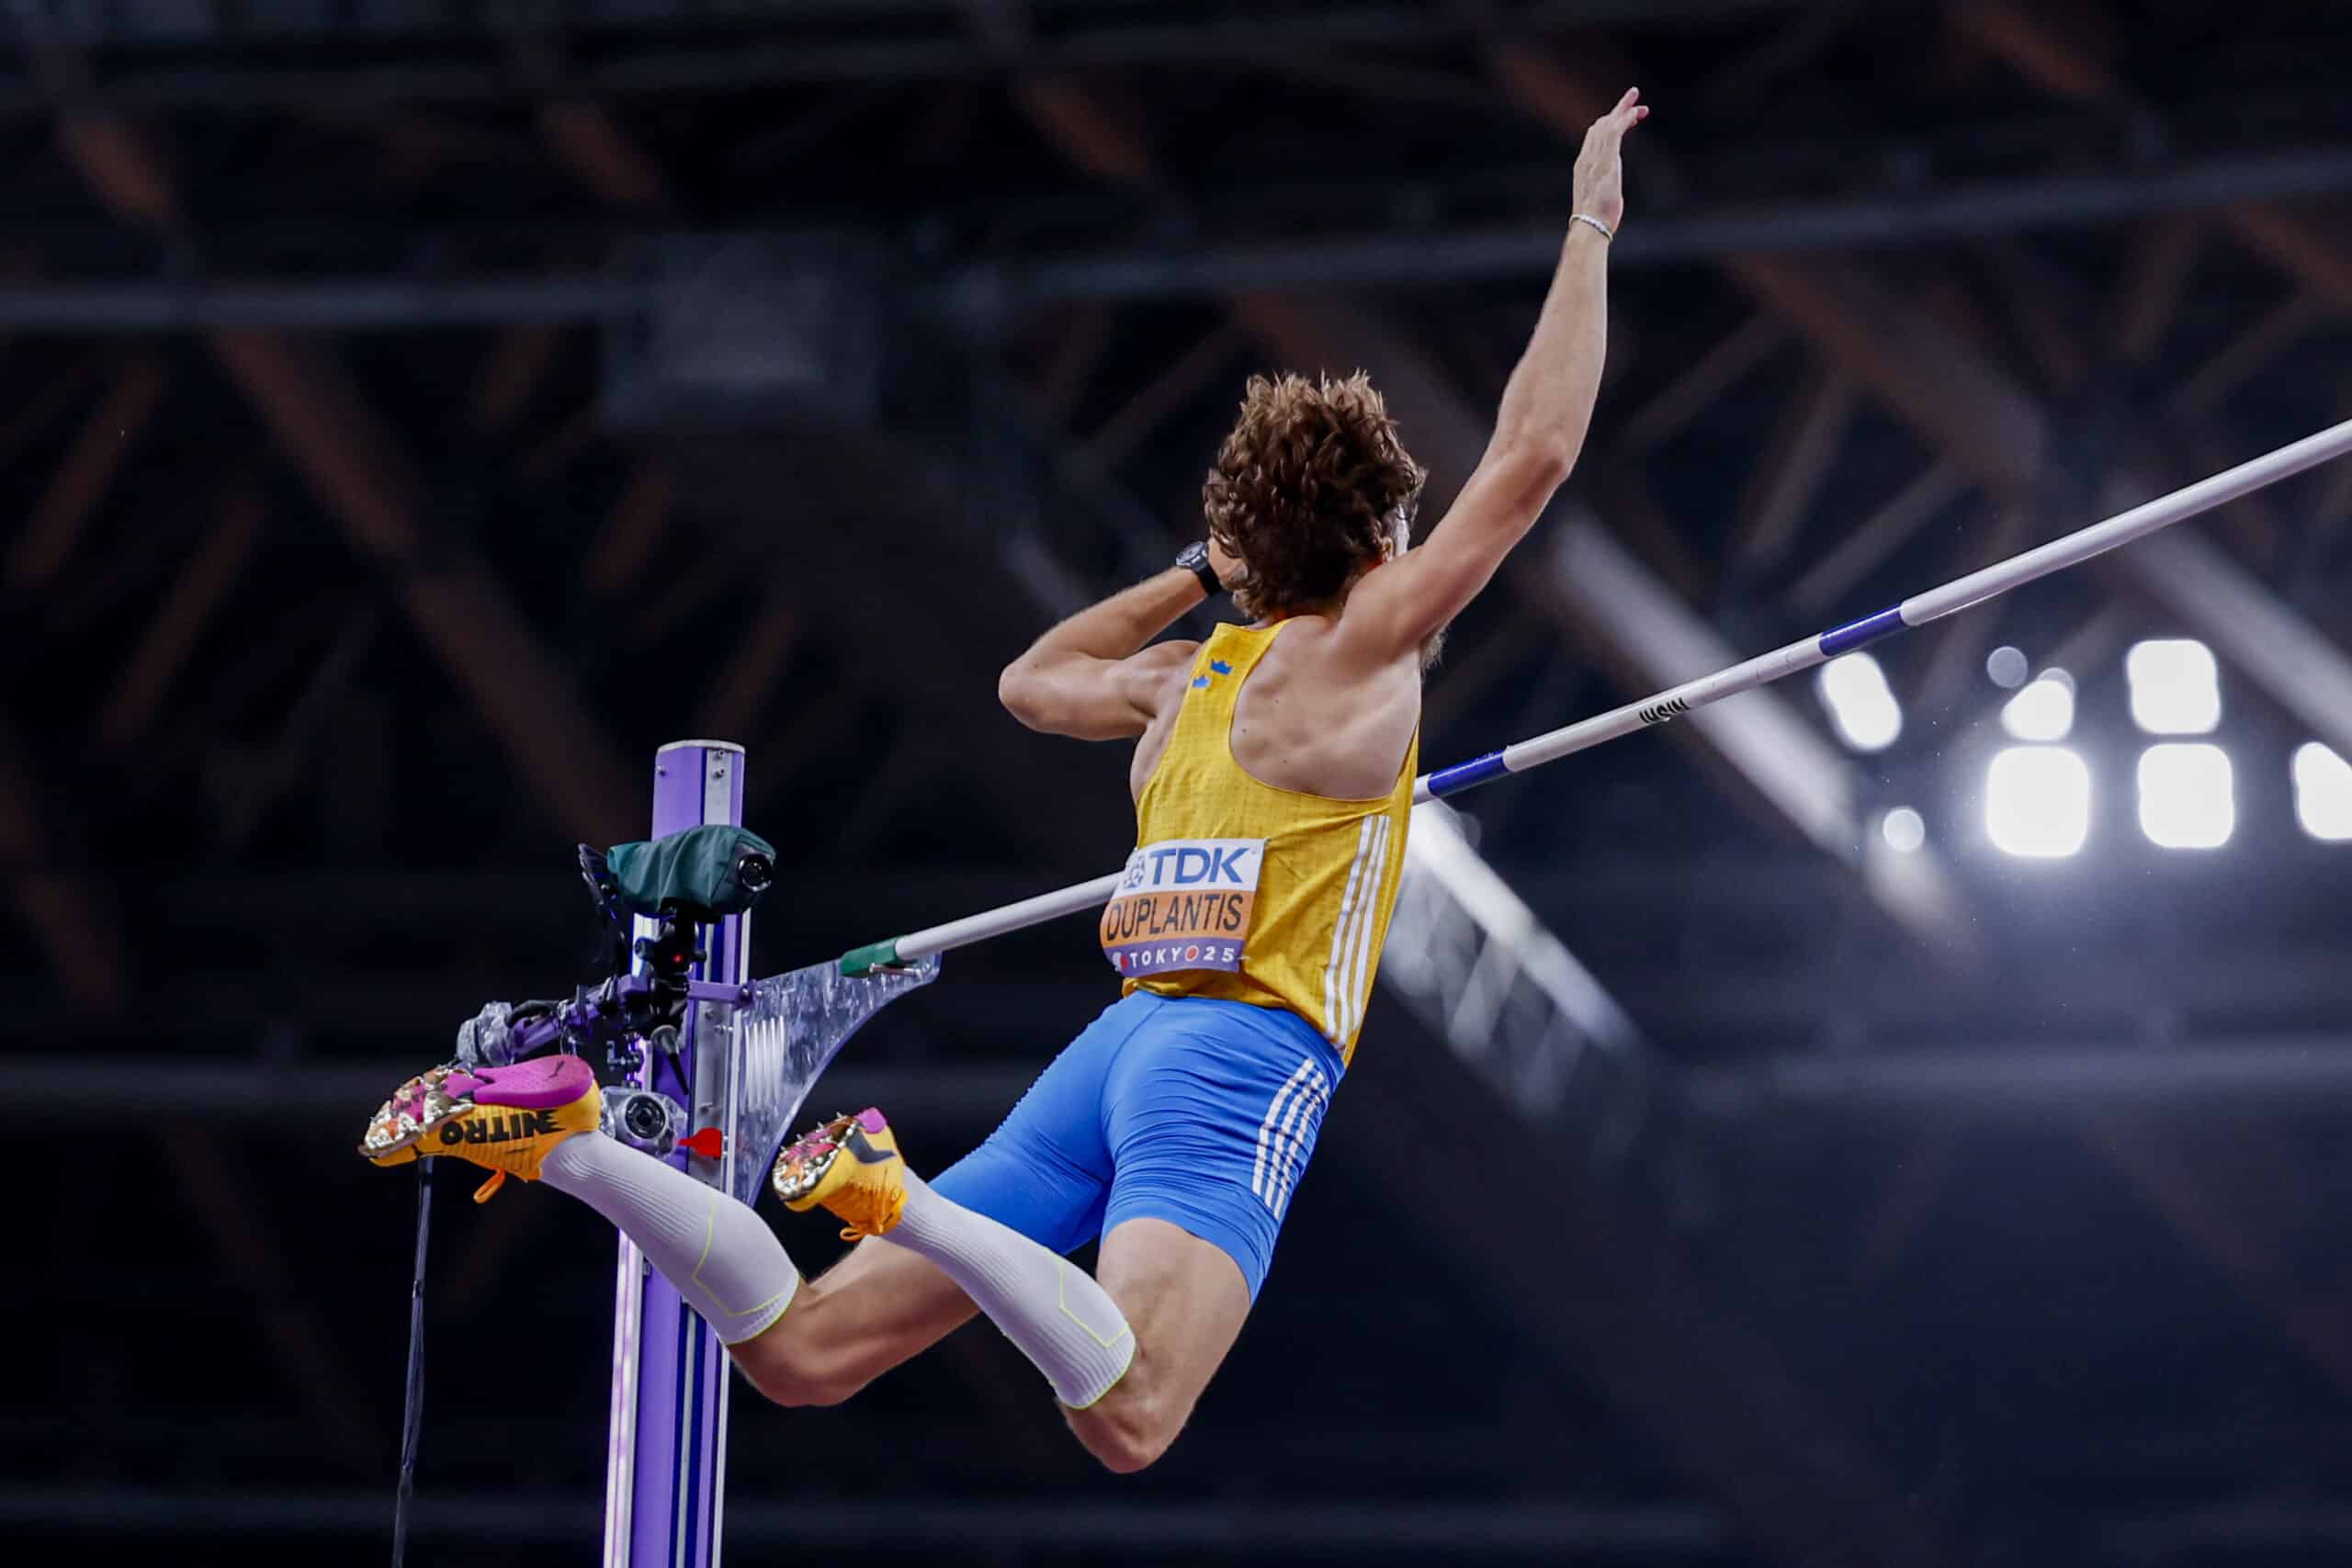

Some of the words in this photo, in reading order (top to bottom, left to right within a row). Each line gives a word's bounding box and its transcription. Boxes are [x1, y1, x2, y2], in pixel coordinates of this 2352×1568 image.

[1149, 847, 1250, 885] TDK
[1106, 894, 1243, 941] DUPLANTIS
[440, 1110, 565, 1145] NITRO
